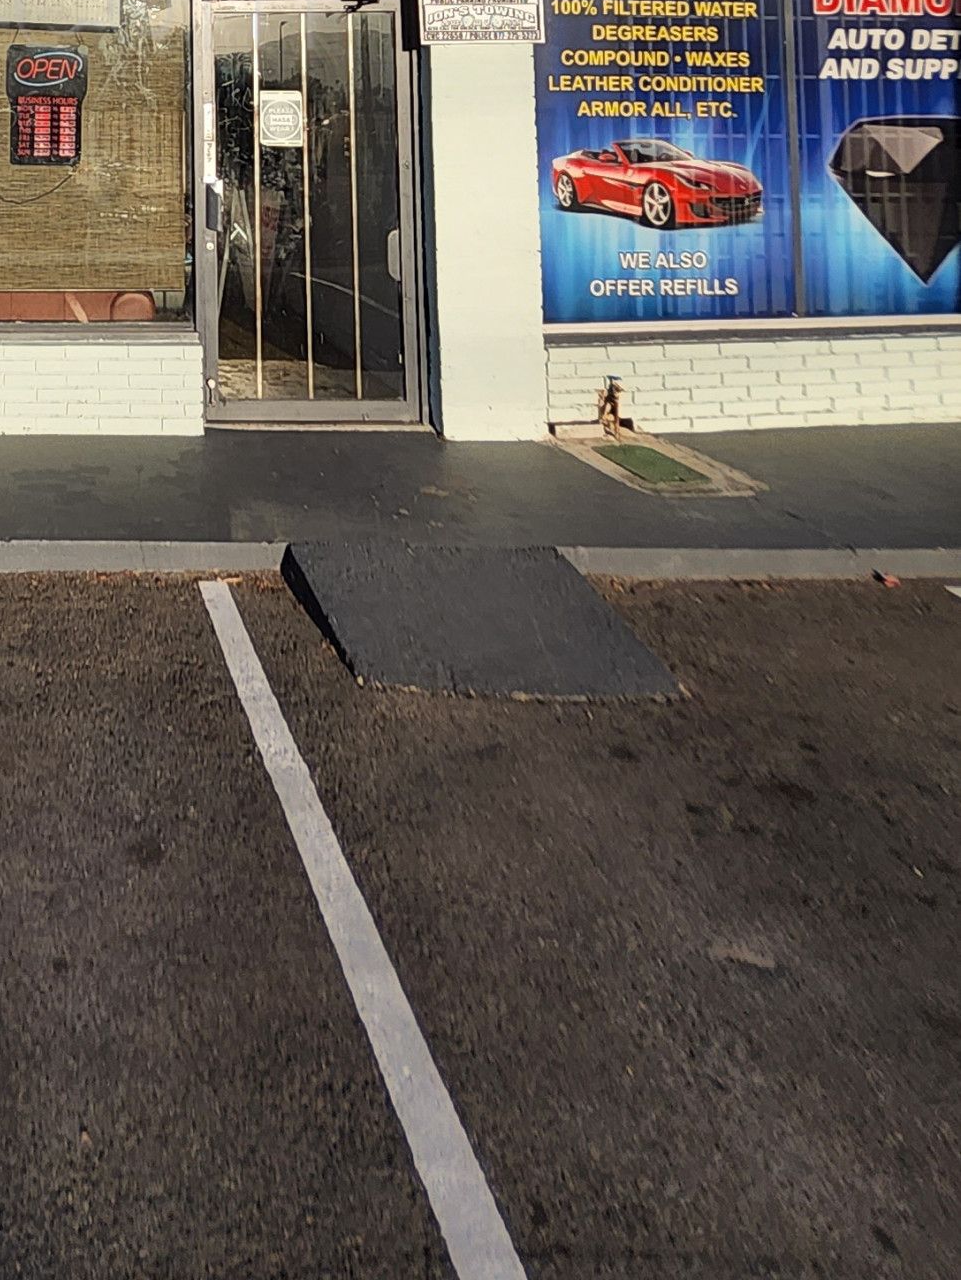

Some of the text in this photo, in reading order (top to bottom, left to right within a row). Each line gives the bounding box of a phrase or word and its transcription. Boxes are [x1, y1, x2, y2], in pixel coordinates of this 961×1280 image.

[473, 6, 536, 23] TOWING
[551, 0, 758, 17] 100% FILTERED WATER
[592, 25, 719, 41] DEGREASERS
[827, 28, 905, 51] AUTO
[561, 50, 750, 67] COMPOUND WAXES
[17, 58, 78, 80] OPEN
[819, 57, 961, 80] AND SUPP
[549, 75, 765, 92] LEATHER CONDITIONER
[17, 96, 78, 105] BUSINESS HOURS
[578, 101, 737, 119] ARMOR ALL, ETC.
[619, 251, 708, 269] WE ALSO
[590, 278, 739, 297] OFFER REFILLS
